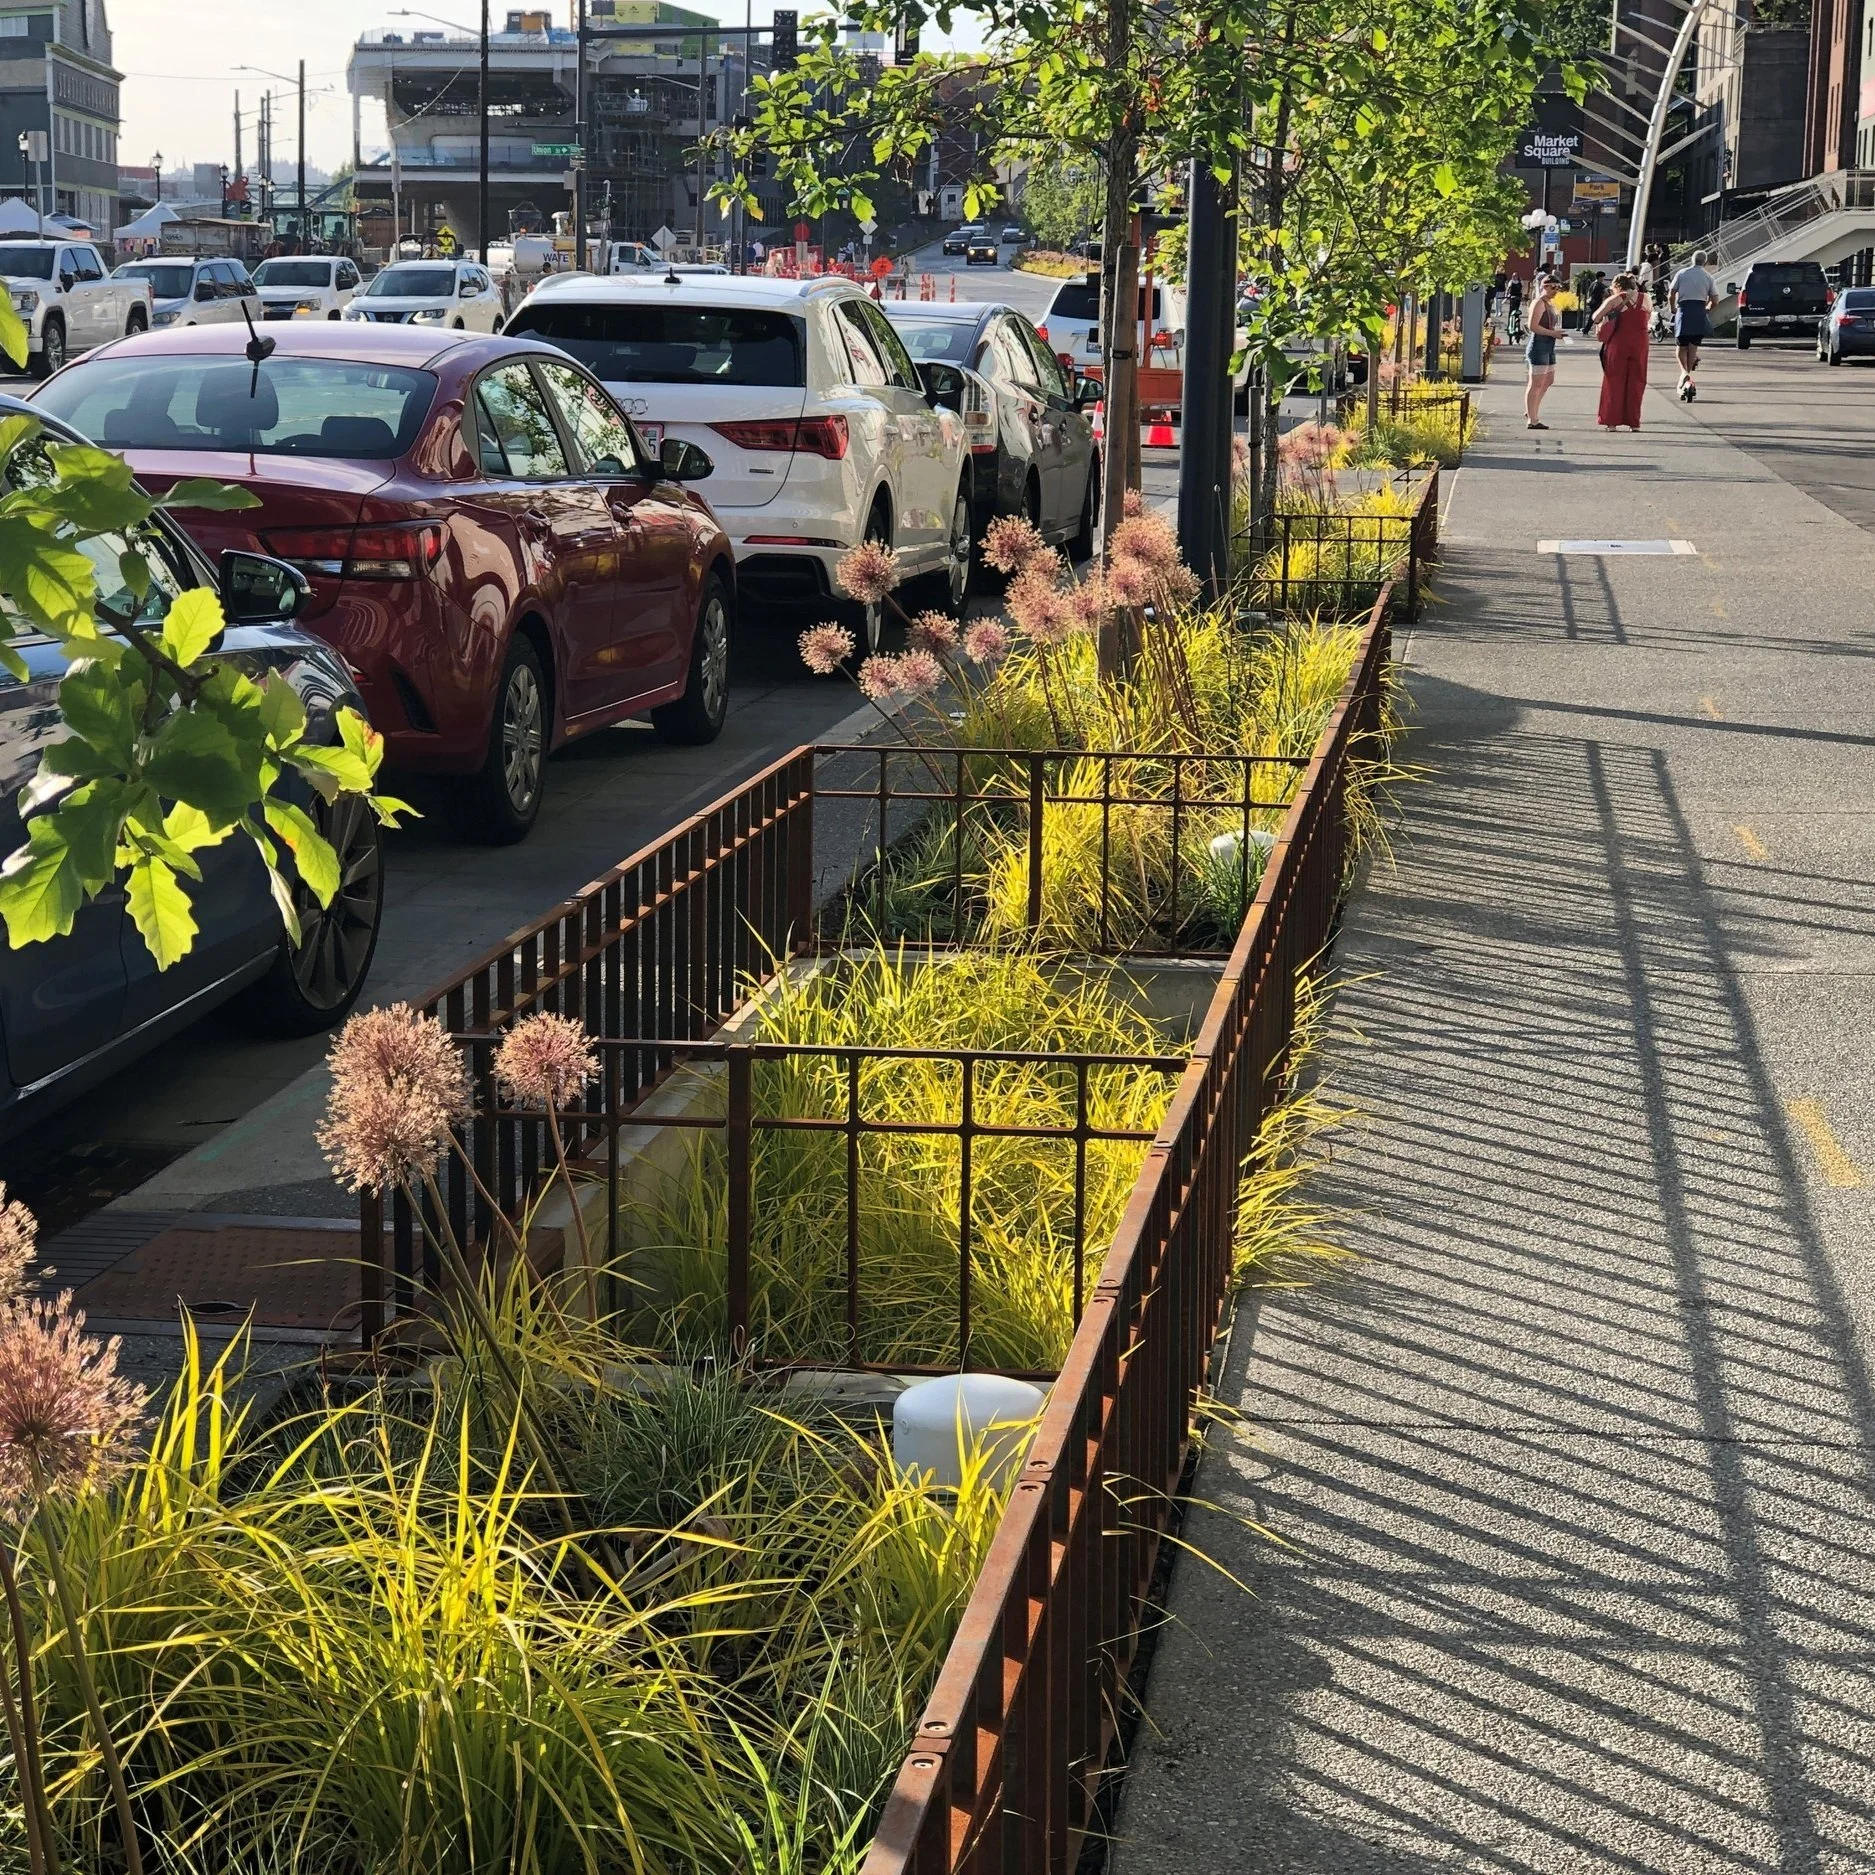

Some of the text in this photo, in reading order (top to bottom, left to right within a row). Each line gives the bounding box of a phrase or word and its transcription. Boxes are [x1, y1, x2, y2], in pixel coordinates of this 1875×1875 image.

[1534, 135, 1578, 147] Market
[533, 146, 552, 154] Union
[1524, 145, 1571, 159] Square
[1541, 157, 1570, 165] BUILDING
[543, 253, 574, 263] WATE
